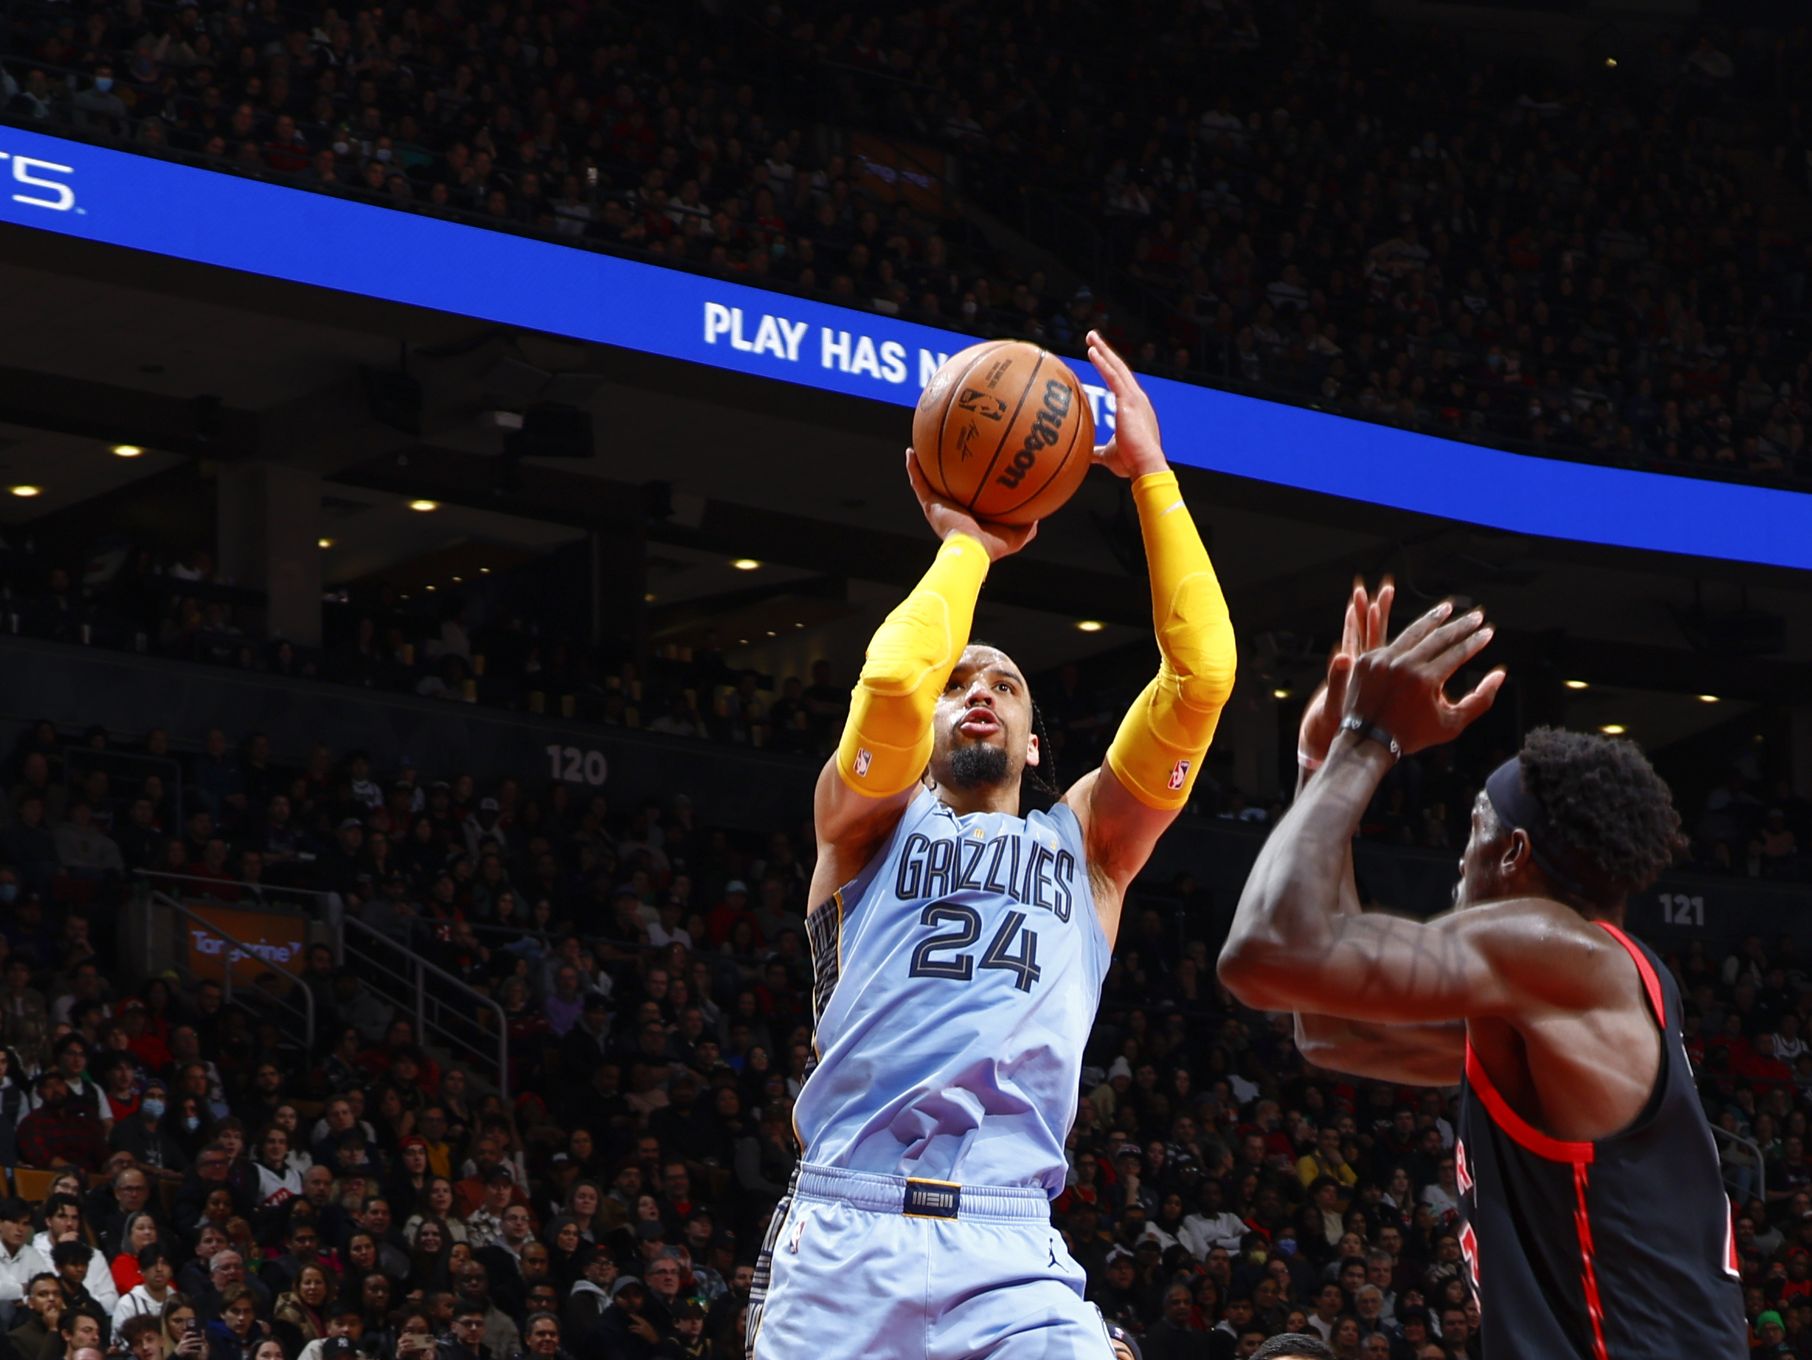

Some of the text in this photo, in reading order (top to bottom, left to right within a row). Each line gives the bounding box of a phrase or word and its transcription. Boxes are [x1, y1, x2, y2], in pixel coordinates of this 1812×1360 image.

[704, 302, 808, 360] PLAY
[821, 328, 907, 384] HAS
[997, 380, 1073, 489] Wilson
[545, 744, 608, 785] 120
[895, 832, 1075, 924] GRIZZLIES
[1658, 893, 1704, 926] 121
[908, 902, 1042, 994] 24
